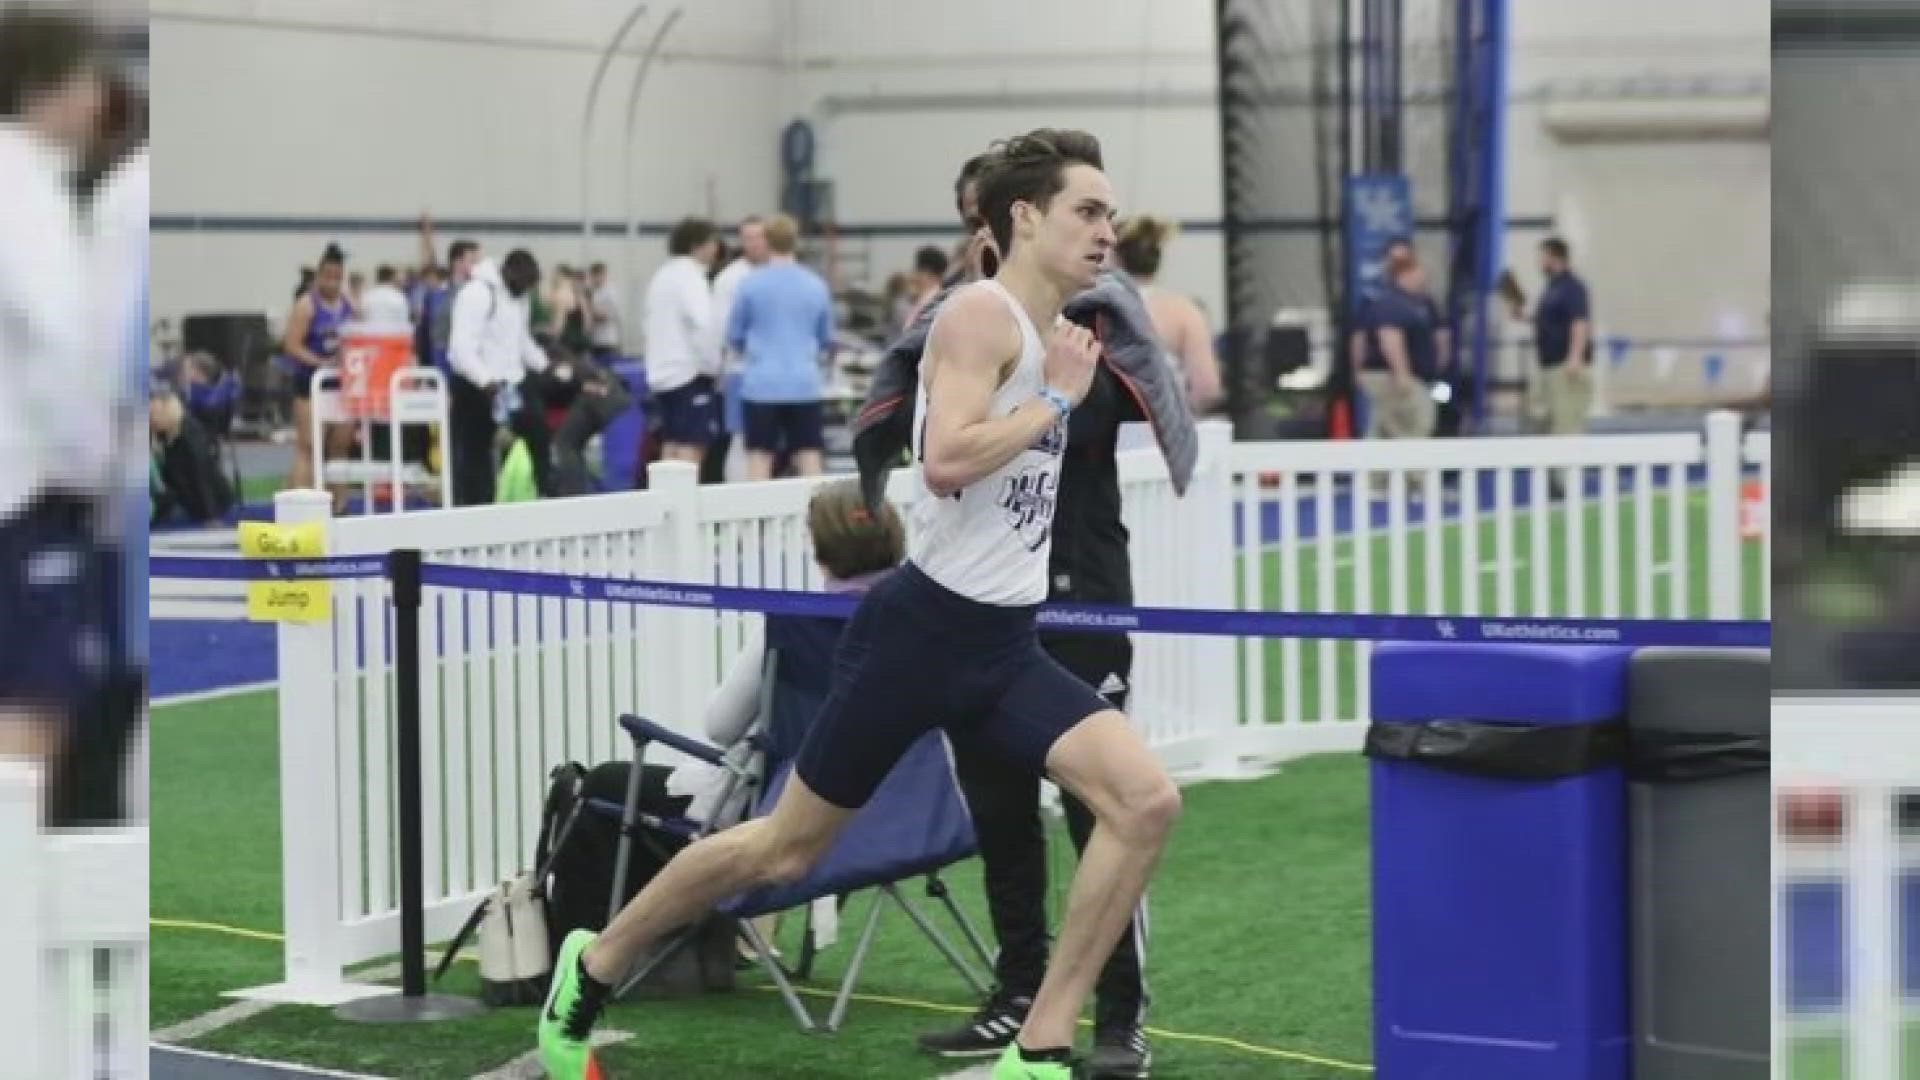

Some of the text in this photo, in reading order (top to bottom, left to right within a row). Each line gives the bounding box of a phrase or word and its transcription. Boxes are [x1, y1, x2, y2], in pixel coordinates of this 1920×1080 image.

[604, 583, 713, 602] UKathletics.com
[1036, 609, 1139, 626] athletics.com
[1481, 623, 1620, 641] UKathletics.com
